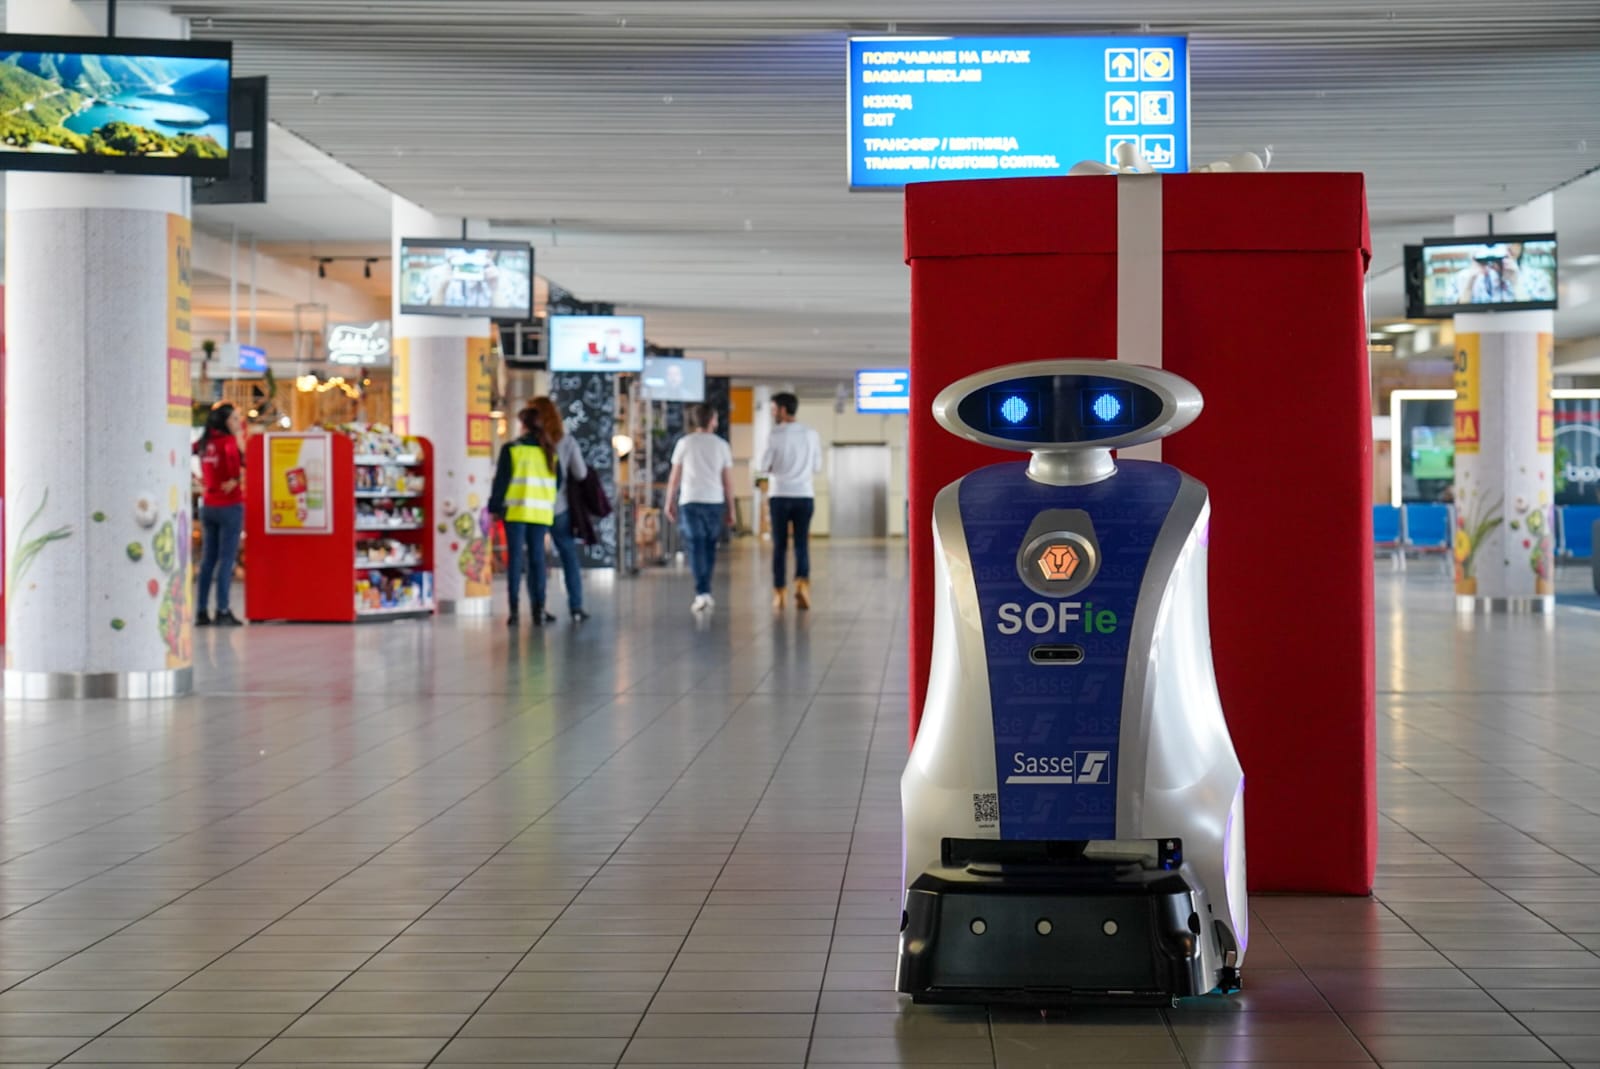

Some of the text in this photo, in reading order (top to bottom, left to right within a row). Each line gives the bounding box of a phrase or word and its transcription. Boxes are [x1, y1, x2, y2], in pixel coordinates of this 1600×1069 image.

[959, 51, 980, 63] НА
[982, 50, 1031, 64] БАГАЖ
[863, 69, 982, 83] BAGGAGE RECLAIM
[863, 95, 913, 110] ИЗХОД
[863, 113, 895, 126] EXIT
[864, 138, 940, 151] ТРАНСФЕР
[949, 137, 1019, 152] МИТНИЦА
[864, 156, 931, 169] TRANSFER
[938, 156, 998, 169] CUSTOMS
[1000, 155, 1060, 169] CONTROL
[997, 602, 1117, 635] SOFie
[1013, 752, 1073, 773] Sasse
